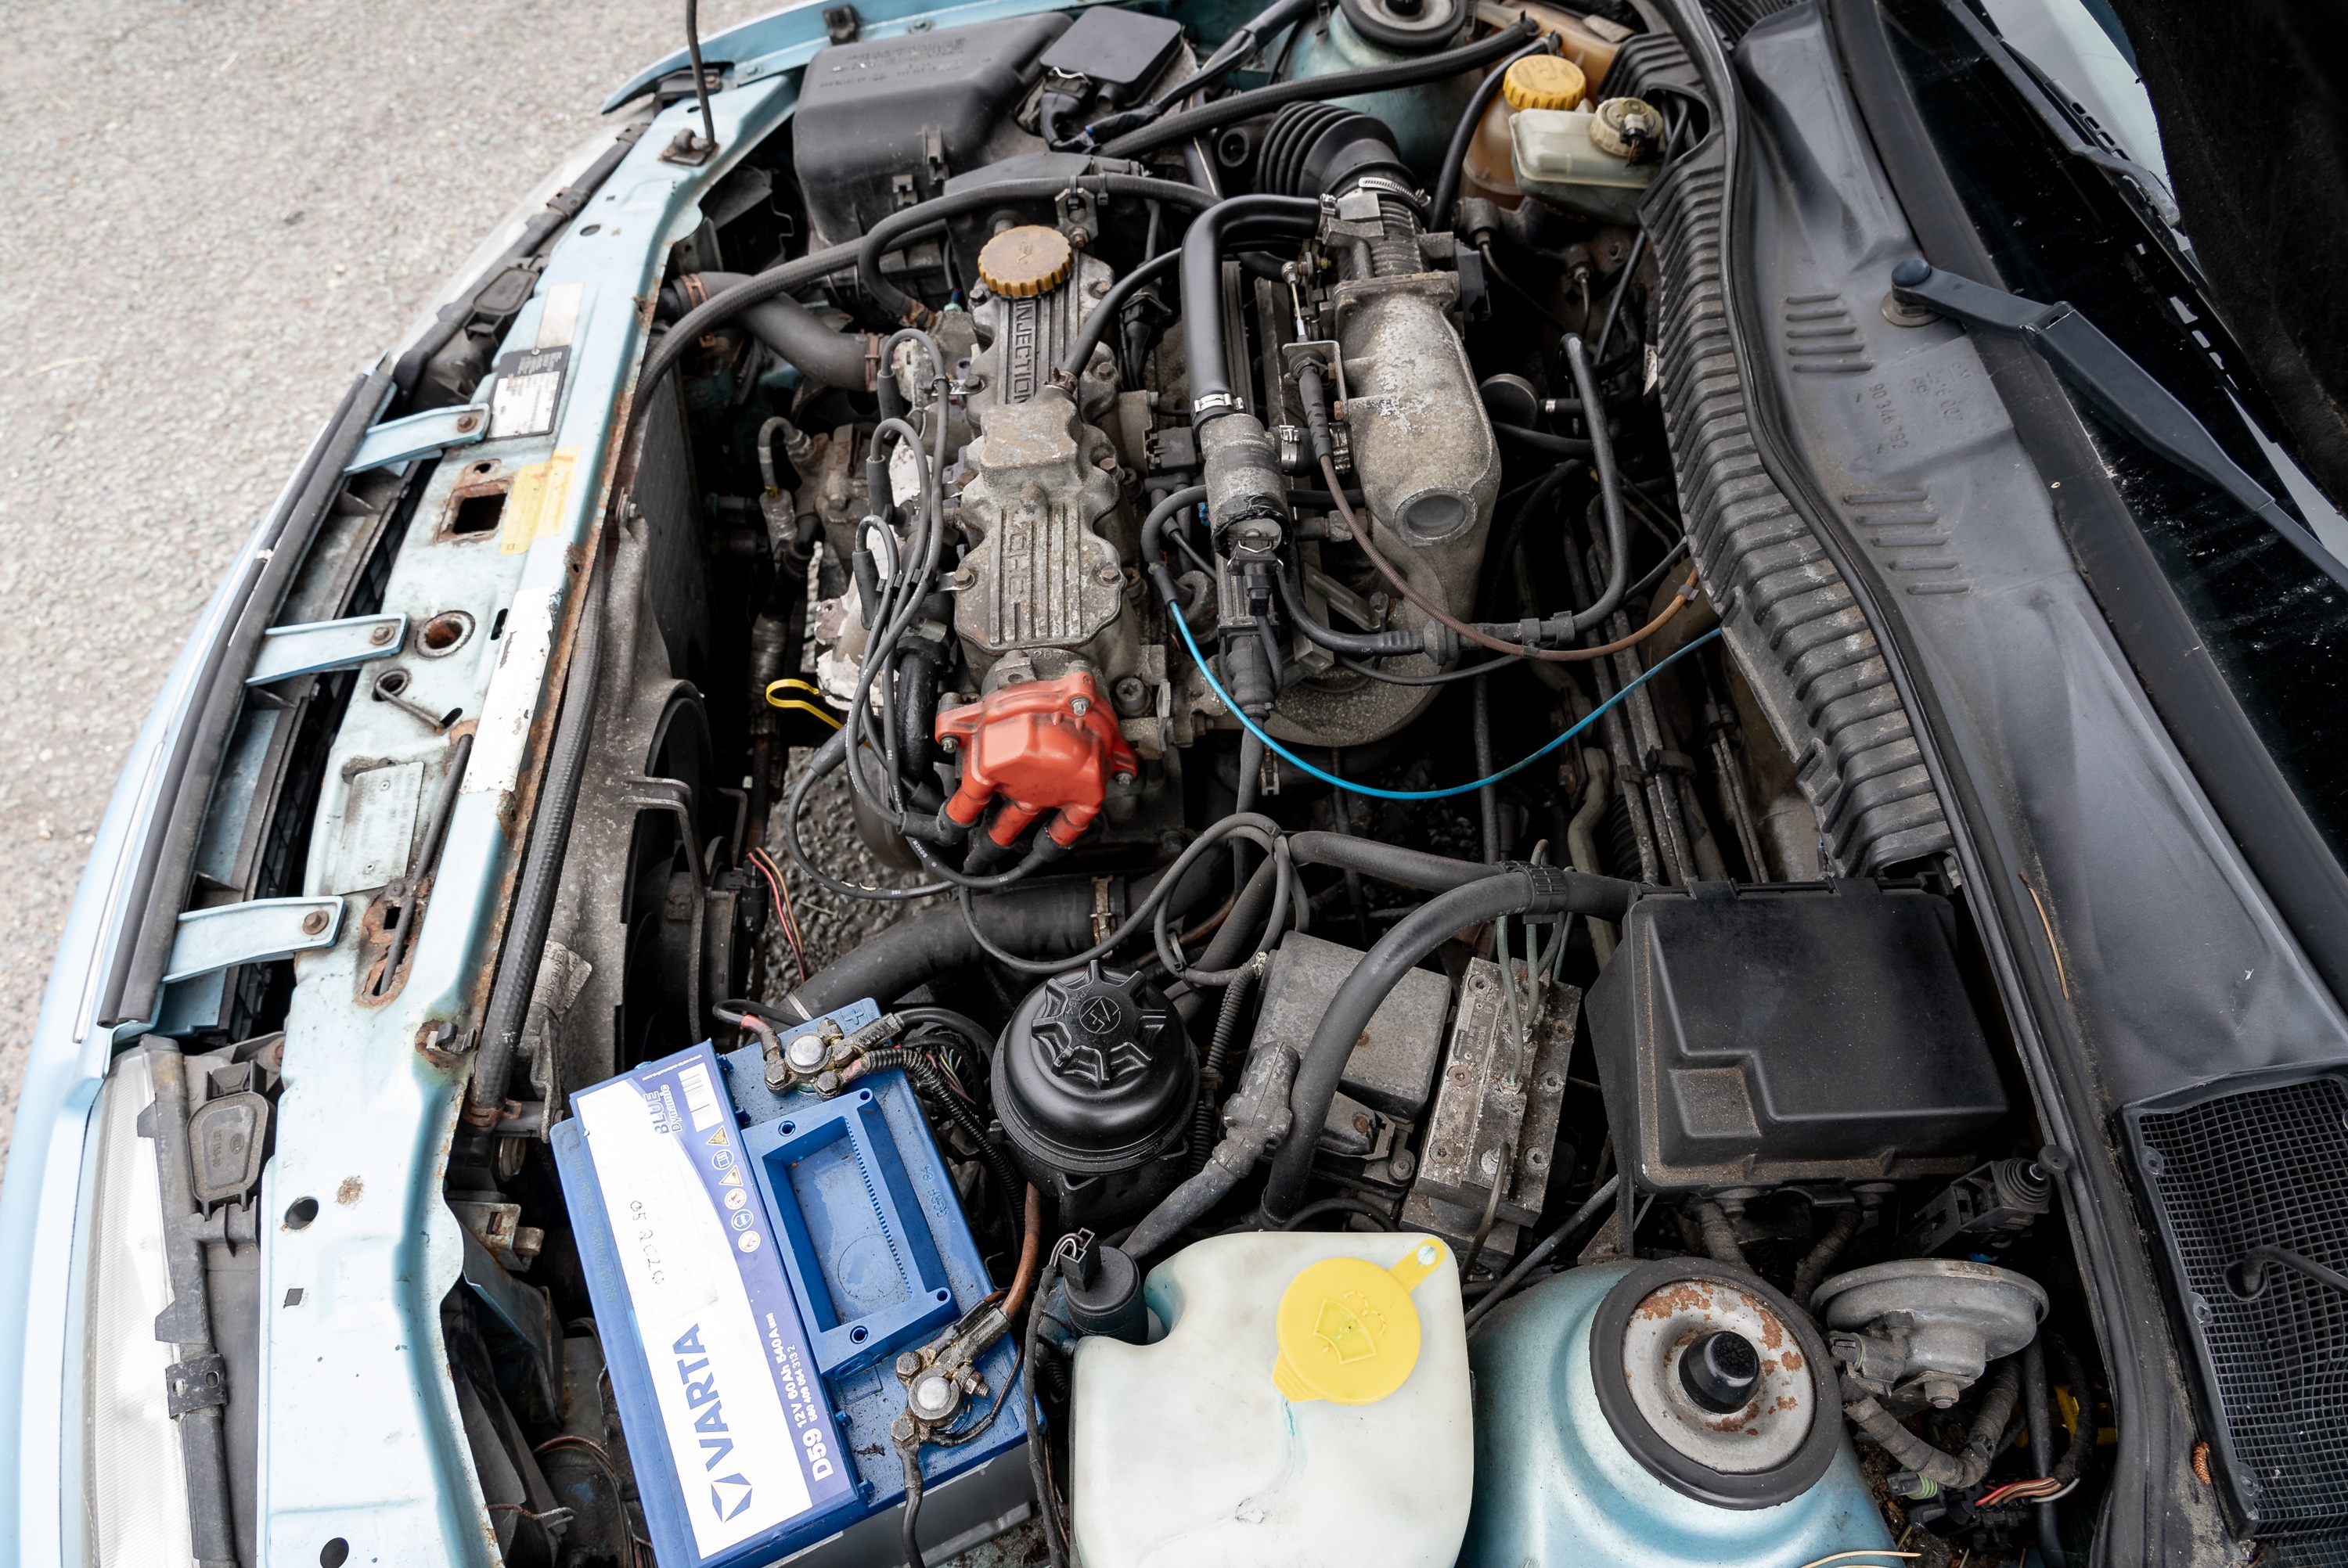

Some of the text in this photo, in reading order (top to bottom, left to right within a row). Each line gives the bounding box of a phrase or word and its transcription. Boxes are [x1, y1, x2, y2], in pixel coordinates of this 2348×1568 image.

[1014, 300, 1032, 404] INJECTION
[1009, 534, 1027, 595] OHC
[912, 840, 928, 858] BOSCH
[643, 1091, 670, 1135] BLUE
[661, 1084, 683, 1133] Dynamic
[789, 1352, 801, 1369] 313
[794, 1368, 806, 1386] 054
[672, 1323, 733, 1472] VARTA
[780, 1364, 799, 1400] 60Ah
[800, 1386, 812, 1404] 409
[790, 1402, 808, 1429] 12V
[802, 1428, 834, 1482] D59
